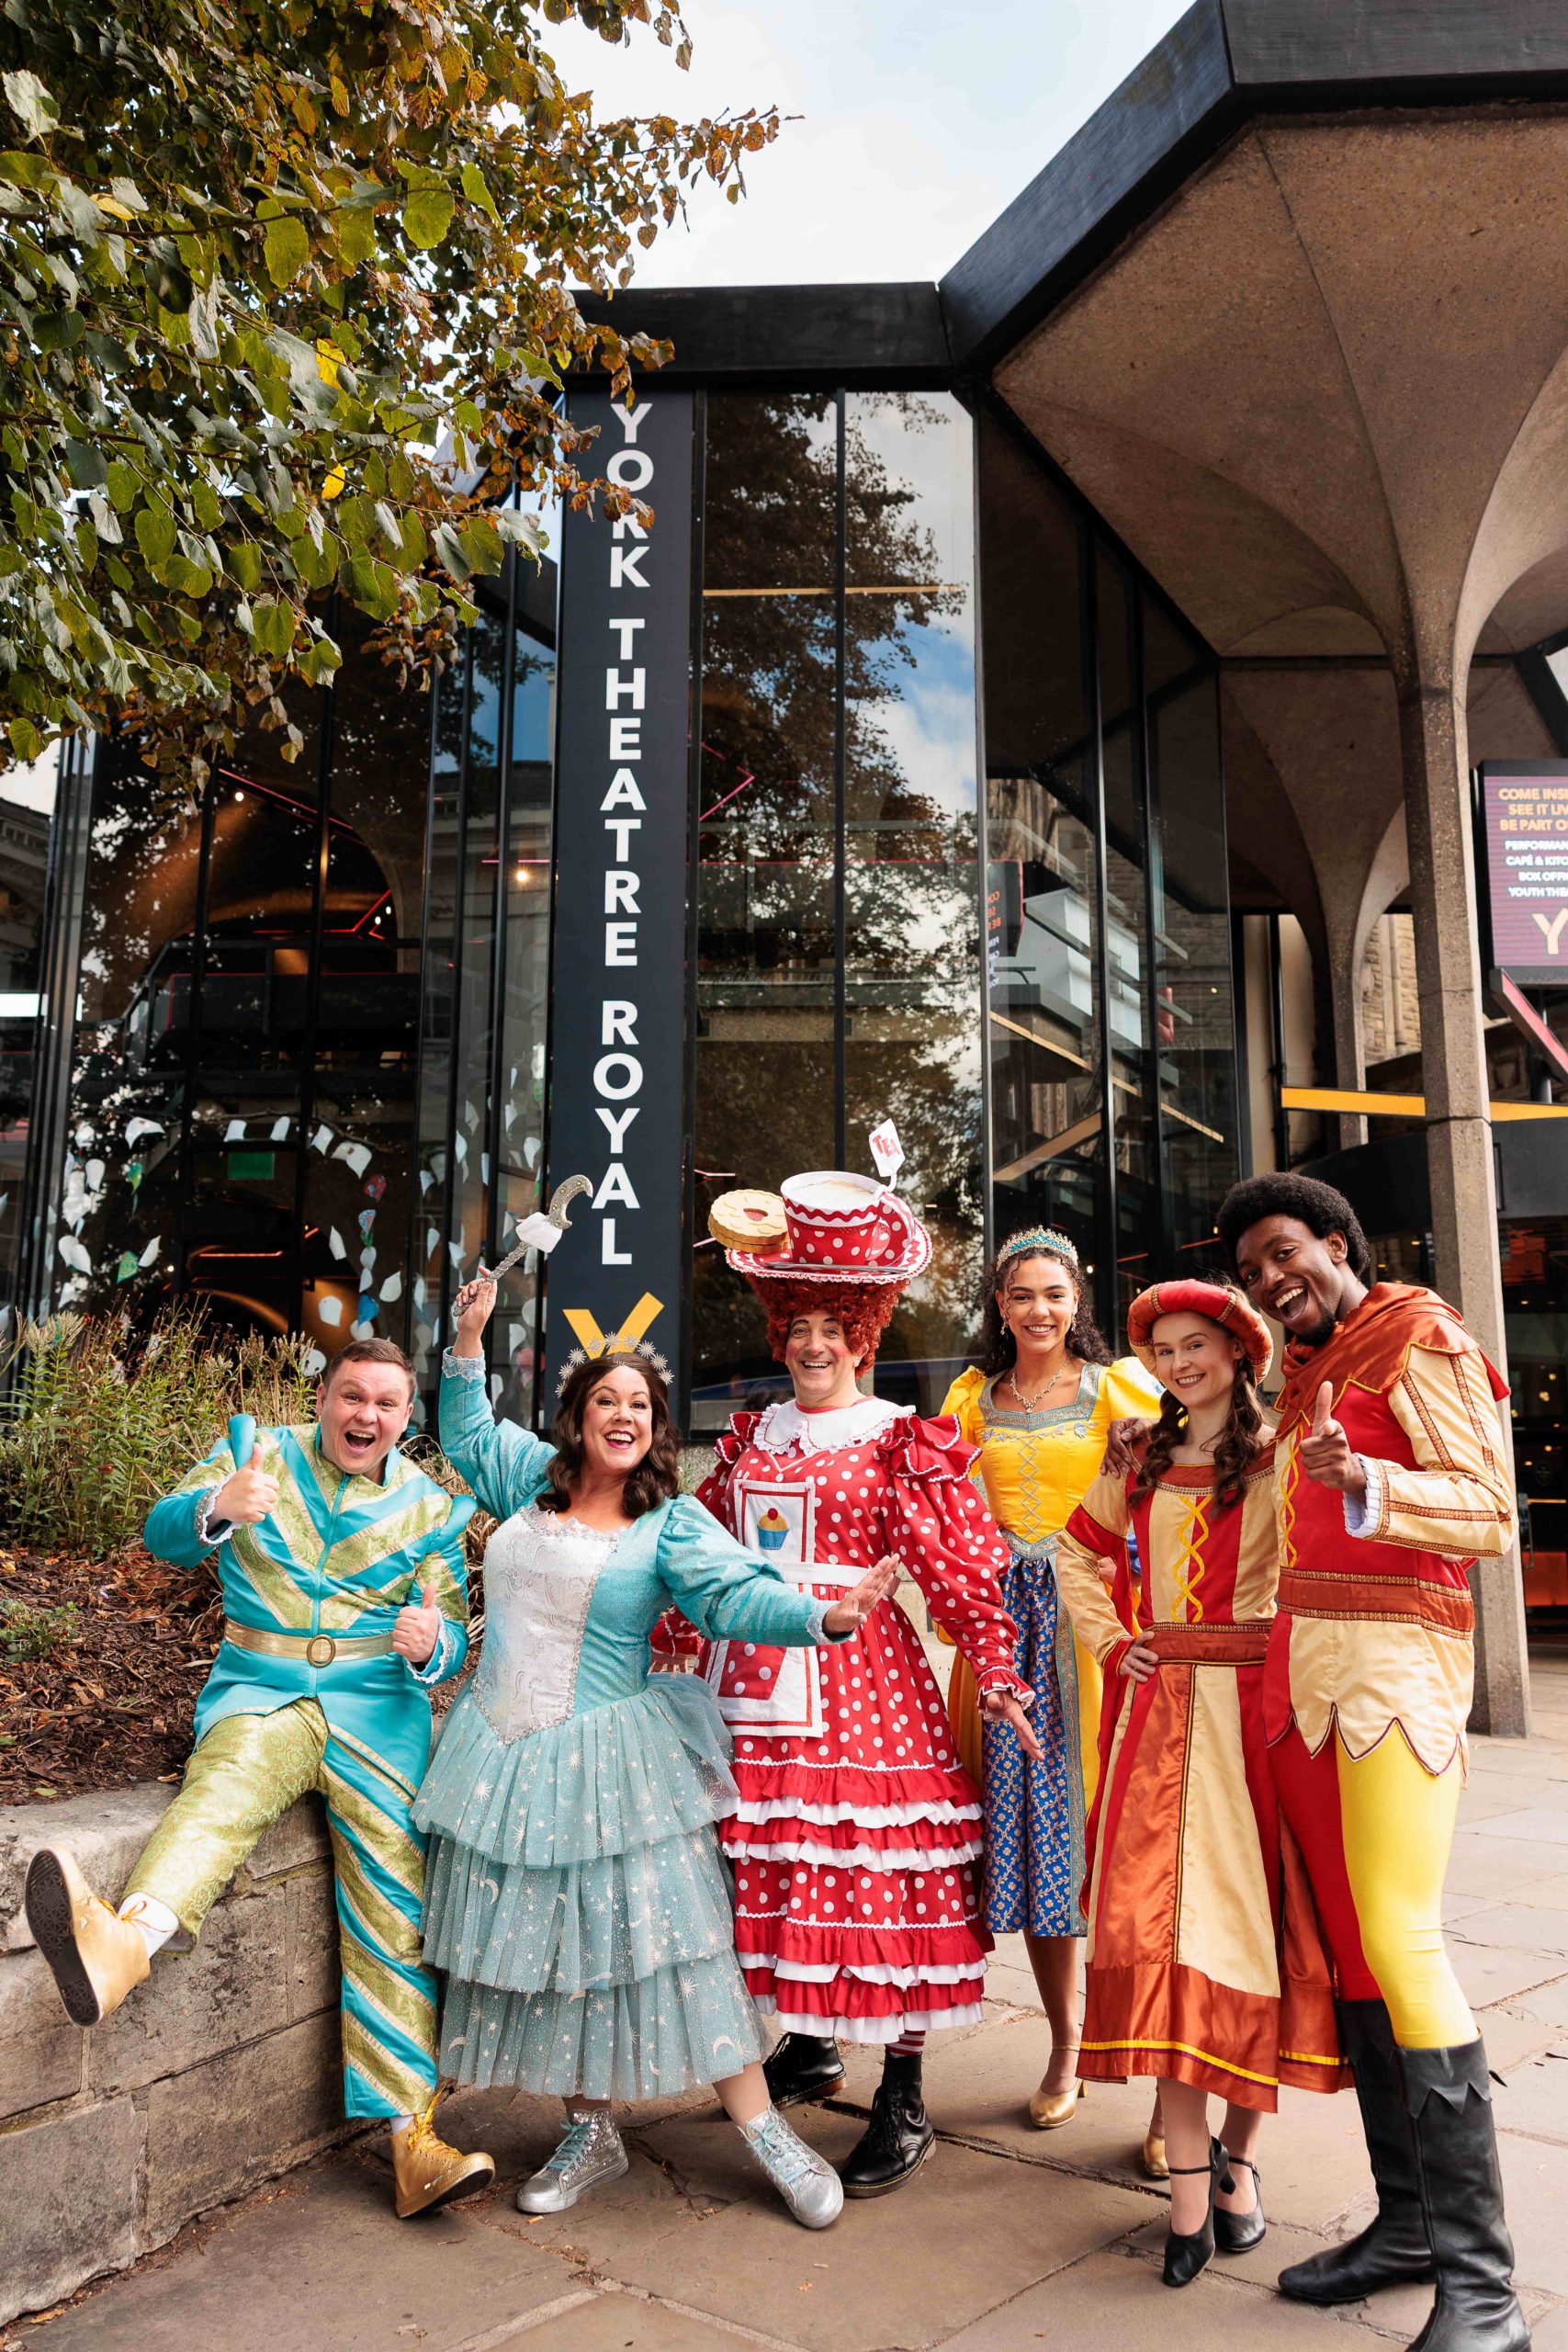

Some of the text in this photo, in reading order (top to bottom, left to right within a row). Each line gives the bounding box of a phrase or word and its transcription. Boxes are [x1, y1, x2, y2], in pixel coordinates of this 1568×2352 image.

[1498, 788, 1540, 800] COME
[1508, 803, 1534, 816] SEE
[1536, 803, 1549, 816] IT
[1499, 819, 1568, 831] BE PART O
[592, 402, 654, 1265] YORK THEATRE ROYAL
[1534, 855, 1544, 866] &
[1518, 871, 1568, 882] BOX OFFI
[1507, 887, 1568, 898] YOUTH THE
[1531, 907, 1568, 956] Y
[872, 1134, 900, 1157] TEA
